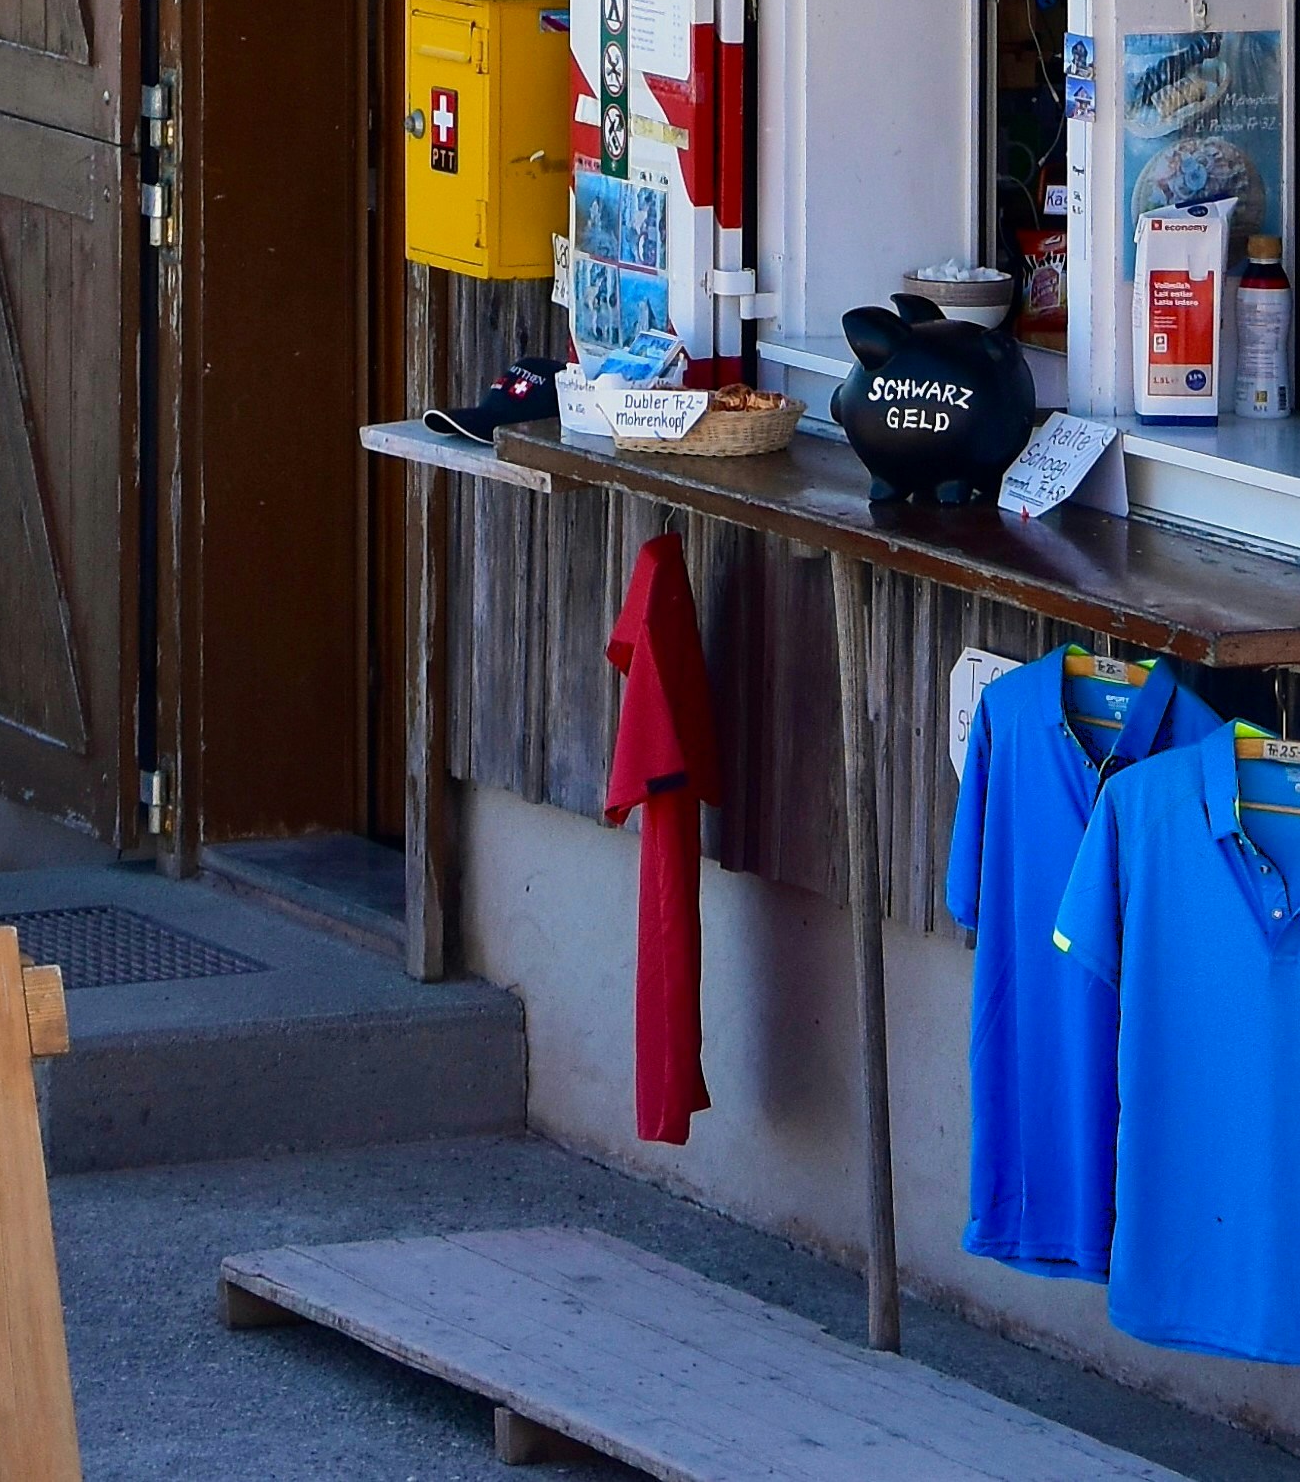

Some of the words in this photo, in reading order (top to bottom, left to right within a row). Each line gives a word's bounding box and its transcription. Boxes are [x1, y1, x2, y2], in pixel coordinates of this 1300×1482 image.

[432, 148, 455, 171] PTT
[1164, 223, 1209, 233] economy
[625, 393, 669, 409] Dubler
[868, 377, 974, 409] SCHWARZ
[886, 407, 950, 433] GELD
[1048, 421, 1092, 452] kalte
[1020, 443, 1073, 484] Schoggi
